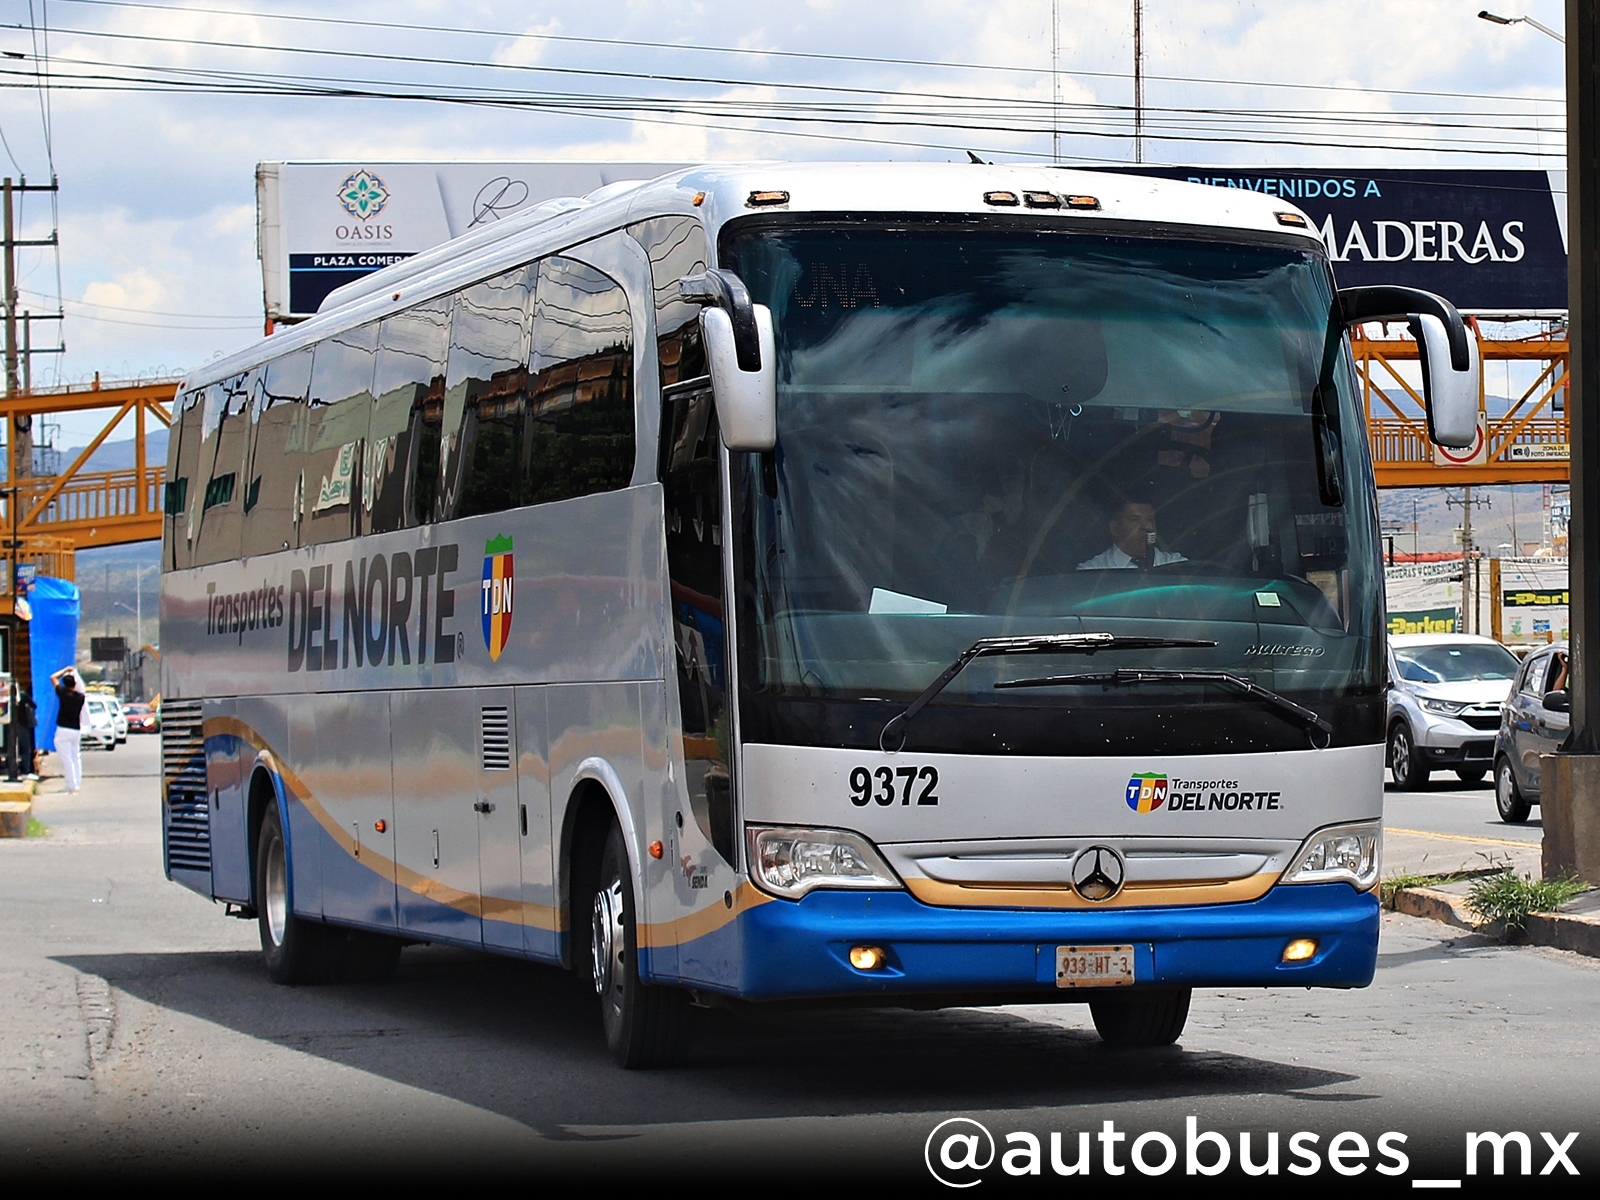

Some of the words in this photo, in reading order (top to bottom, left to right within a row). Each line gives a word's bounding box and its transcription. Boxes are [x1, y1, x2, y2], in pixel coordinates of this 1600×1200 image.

[1363, 180, 1382, 198] A
[335, 225, 393, 239] OASIS
[314, 257, 355, 266] PLAZA
[482, 577, 513, 615] TDN
[206, 579, 284, 646] Transportes
[287, 564, 338, 672] DEL
[342, 544, 459, 669] NORTE
[1389, 616, 1454, 635] Parker
[849, 765, 938, 806] 9372
[1128, 786, 1167, 800] TDN
[1172, 778, 1238, 791] Transportes
[1168, 793, 1205, 811] DEL
[1208, 792, 1281, 811] NORTE
